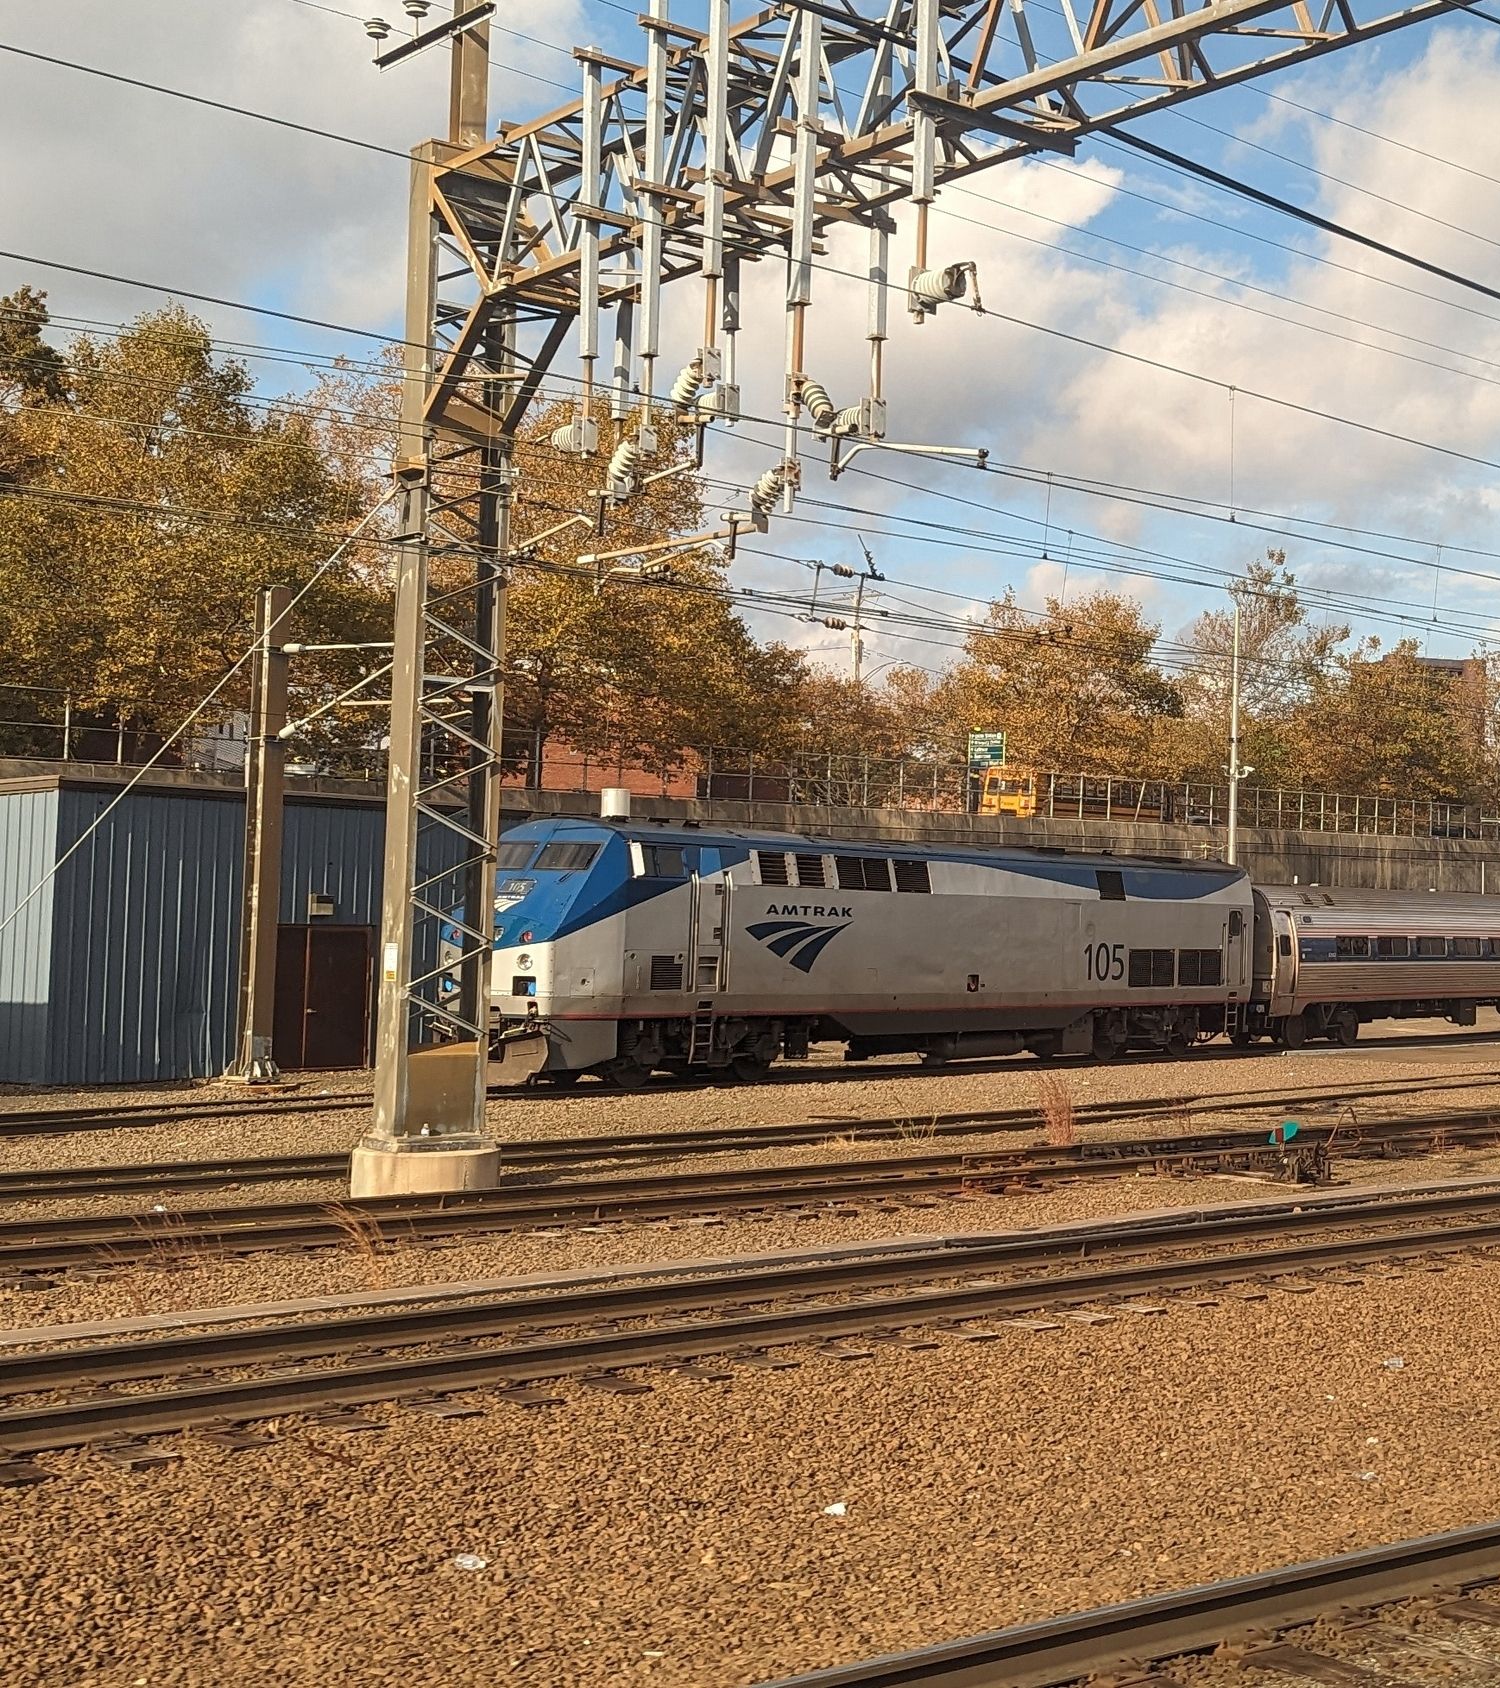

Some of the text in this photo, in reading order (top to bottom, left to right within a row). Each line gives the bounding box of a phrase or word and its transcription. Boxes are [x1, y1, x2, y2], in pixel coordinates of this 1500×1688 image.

[509, 882, 527, 892] 105
[766, 904, 853, 917] AMTRAK
[1084, 942, 1125, 981] 105
